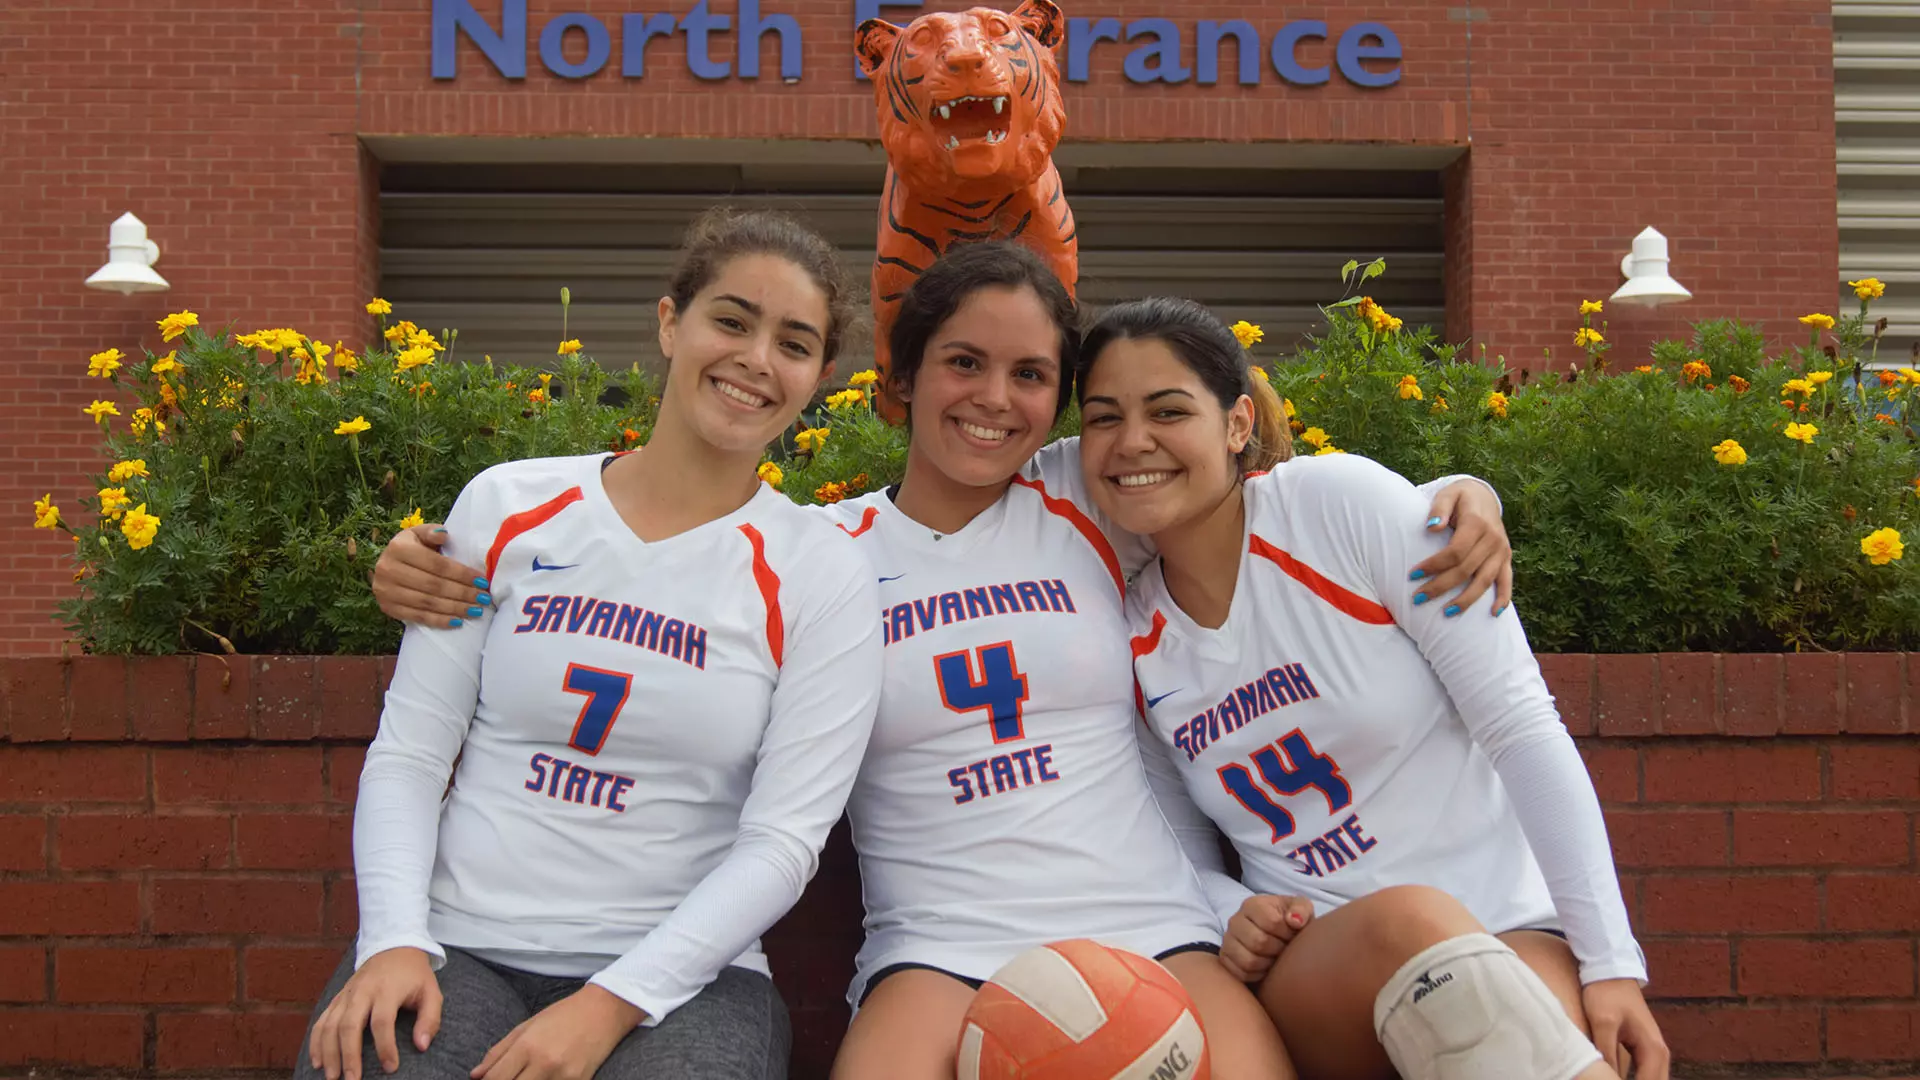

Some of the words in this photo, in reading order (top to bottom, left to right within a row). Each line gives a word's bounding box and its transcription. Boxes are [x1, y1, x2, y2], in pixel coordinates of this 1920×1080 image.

[431, 0, 802, 79] North
[514, 595, 707, 671] SAVANNAH
[562, 662, 634, 757] 7
[933, 640, 1029, 744] 4
[1173, 662, 1320, 763] SAVANNAH
[525, 752, 635, 813] STATE
[947, 744, 1060, 805] STATE
[1216, 727, 1353, 844] 14
